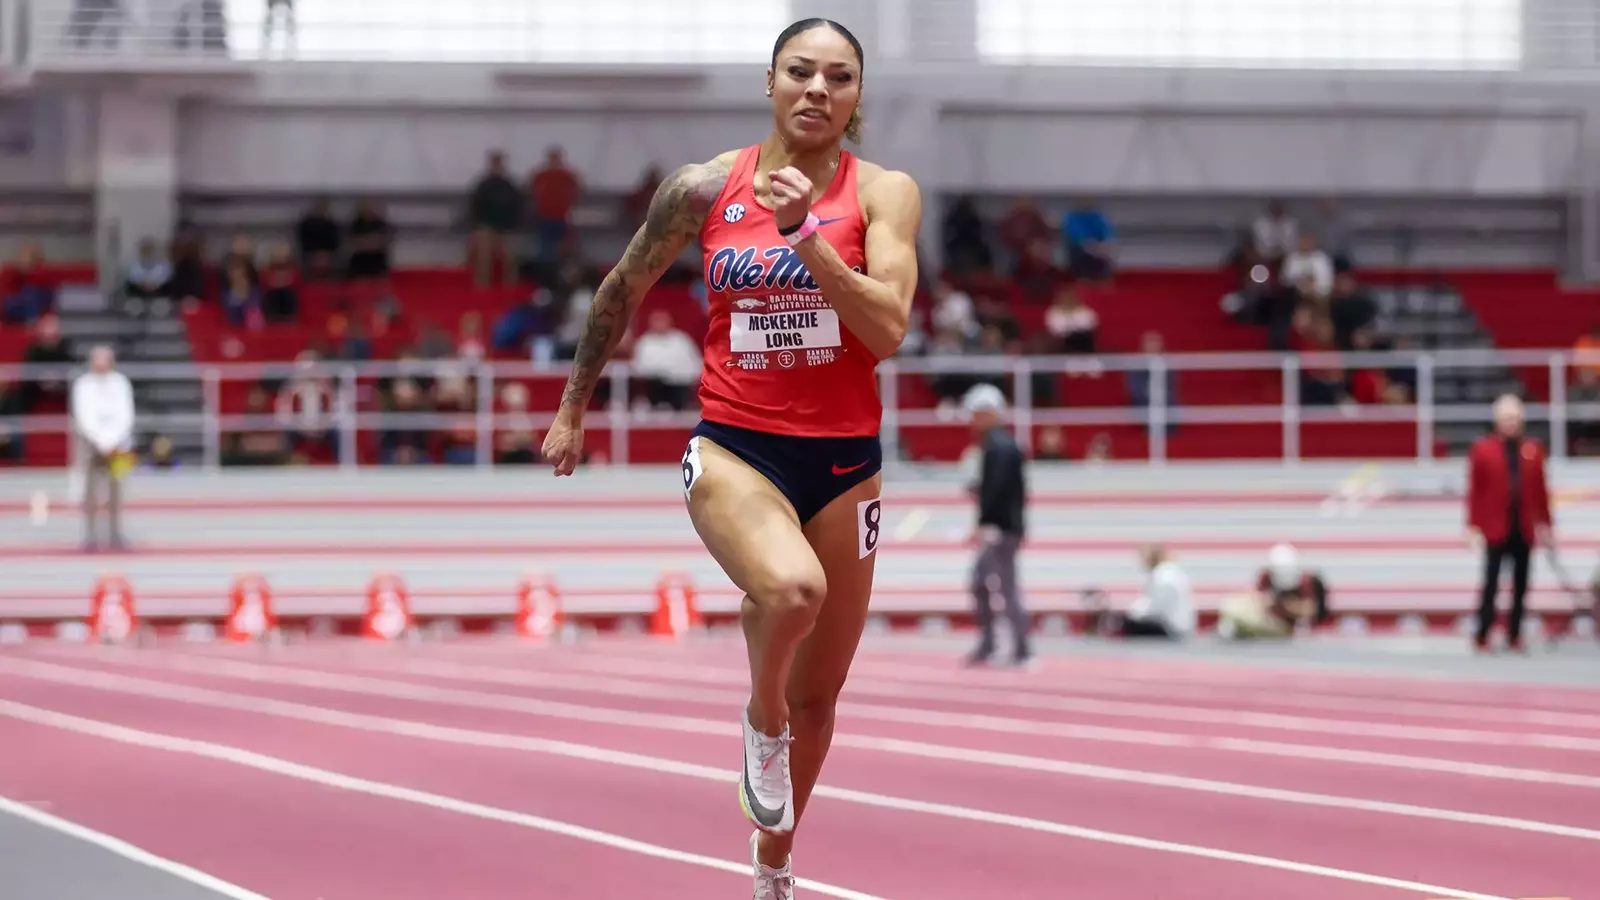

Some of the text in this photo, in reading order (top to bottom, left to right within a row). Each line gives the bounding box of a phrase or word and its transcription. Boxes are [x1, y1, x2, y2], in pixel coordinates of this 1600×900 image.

[724, 203, 745, 222] SEC
[709, 246, 764, 292] Ole
[748, 312, 818, 331] MCKENZIE
[765, 333, 804, 348] LONG
[865, 500, 881, 551] 8
